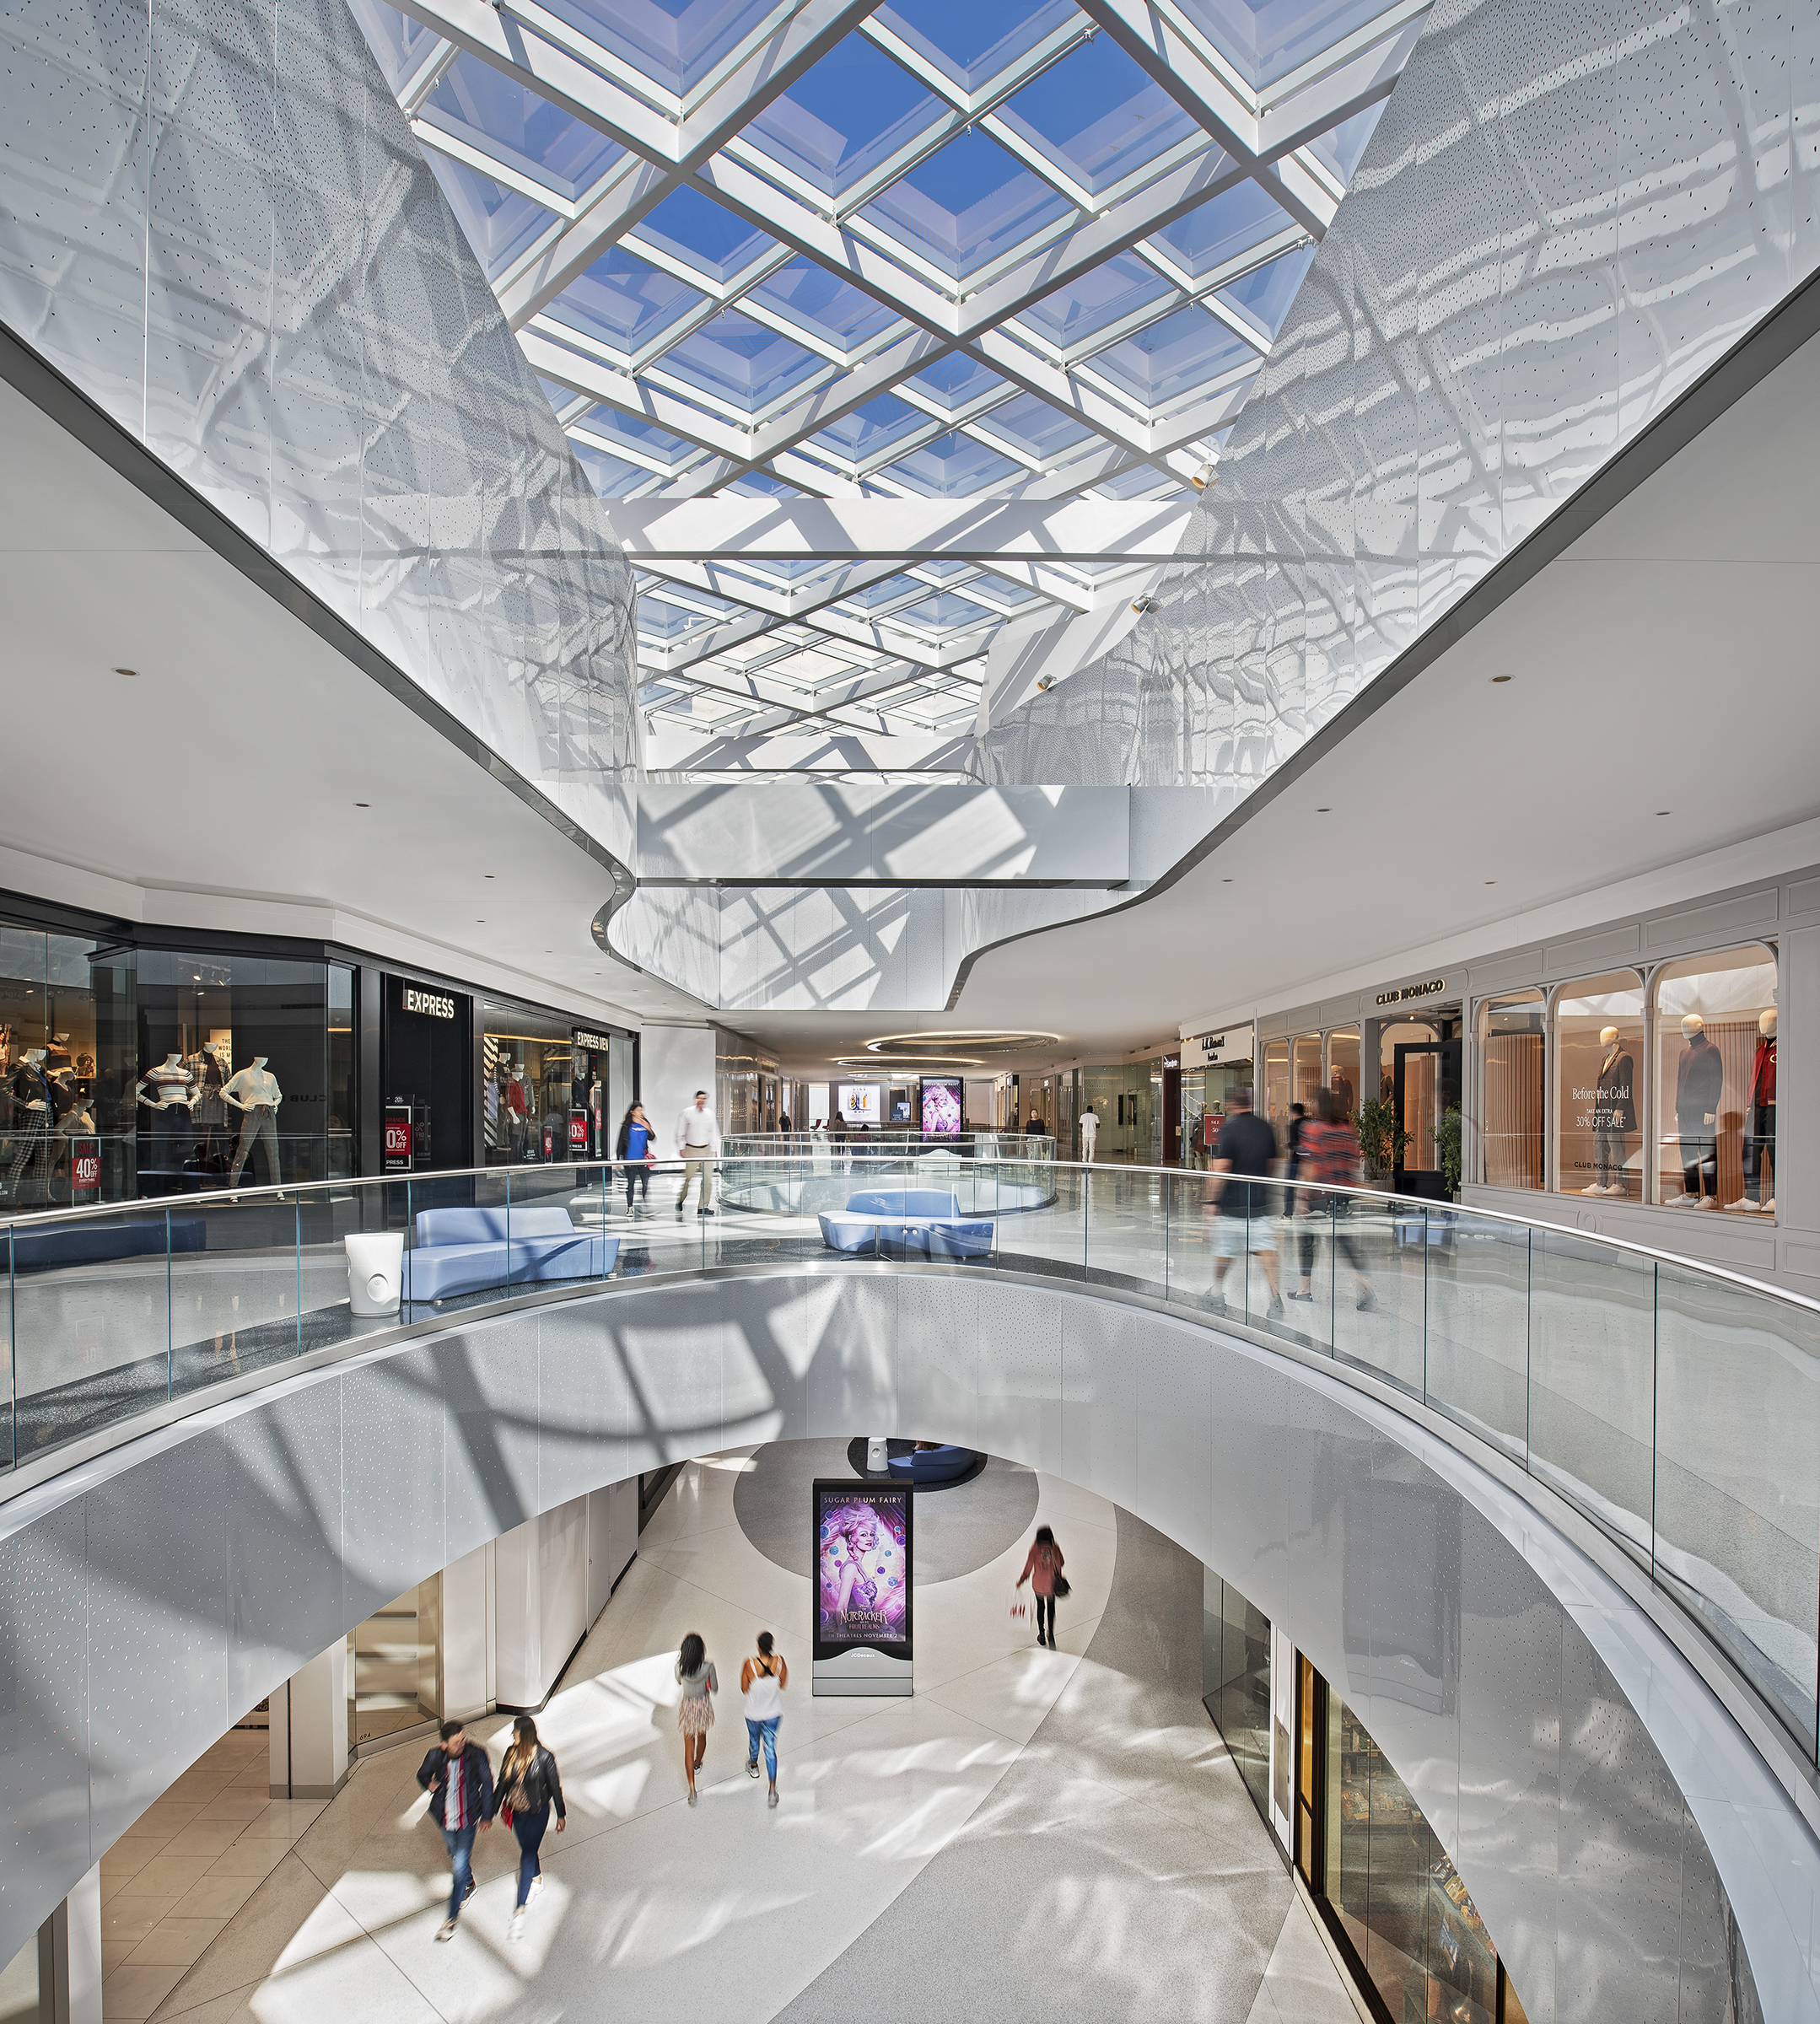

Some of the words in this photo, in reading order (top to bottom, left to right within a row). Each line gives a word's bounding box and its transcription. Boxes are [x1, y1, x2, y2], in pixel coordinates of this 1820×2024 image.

[1376, 990, 1400, 1005] CLUB
[1401, 979, 1444, 1000] MONACO
[407, 989, 455, 1019] EXPRESS
[578, 1031, 599, 1050] EXPRESS
[600, 1037, 609, 1051] MEN
[1572, 1086, 1596, 1100] Before
[1597, 1085, 1609, 1100] the
[1610, 1085, 1629, 1100] Cold
[1575, 1116, 1591, 1127] 30%
[1591, 1116, 1606, 1128] OFF
[386, 1129, 407, 1149] 0%
[78, 1143, 93, 1155] SALE
[76, 1158, 98, 1178] 40%
[1593, 1163, 1623, 1171] MONACO
[840, 1609, 888, 1625] NUTCRACKER
